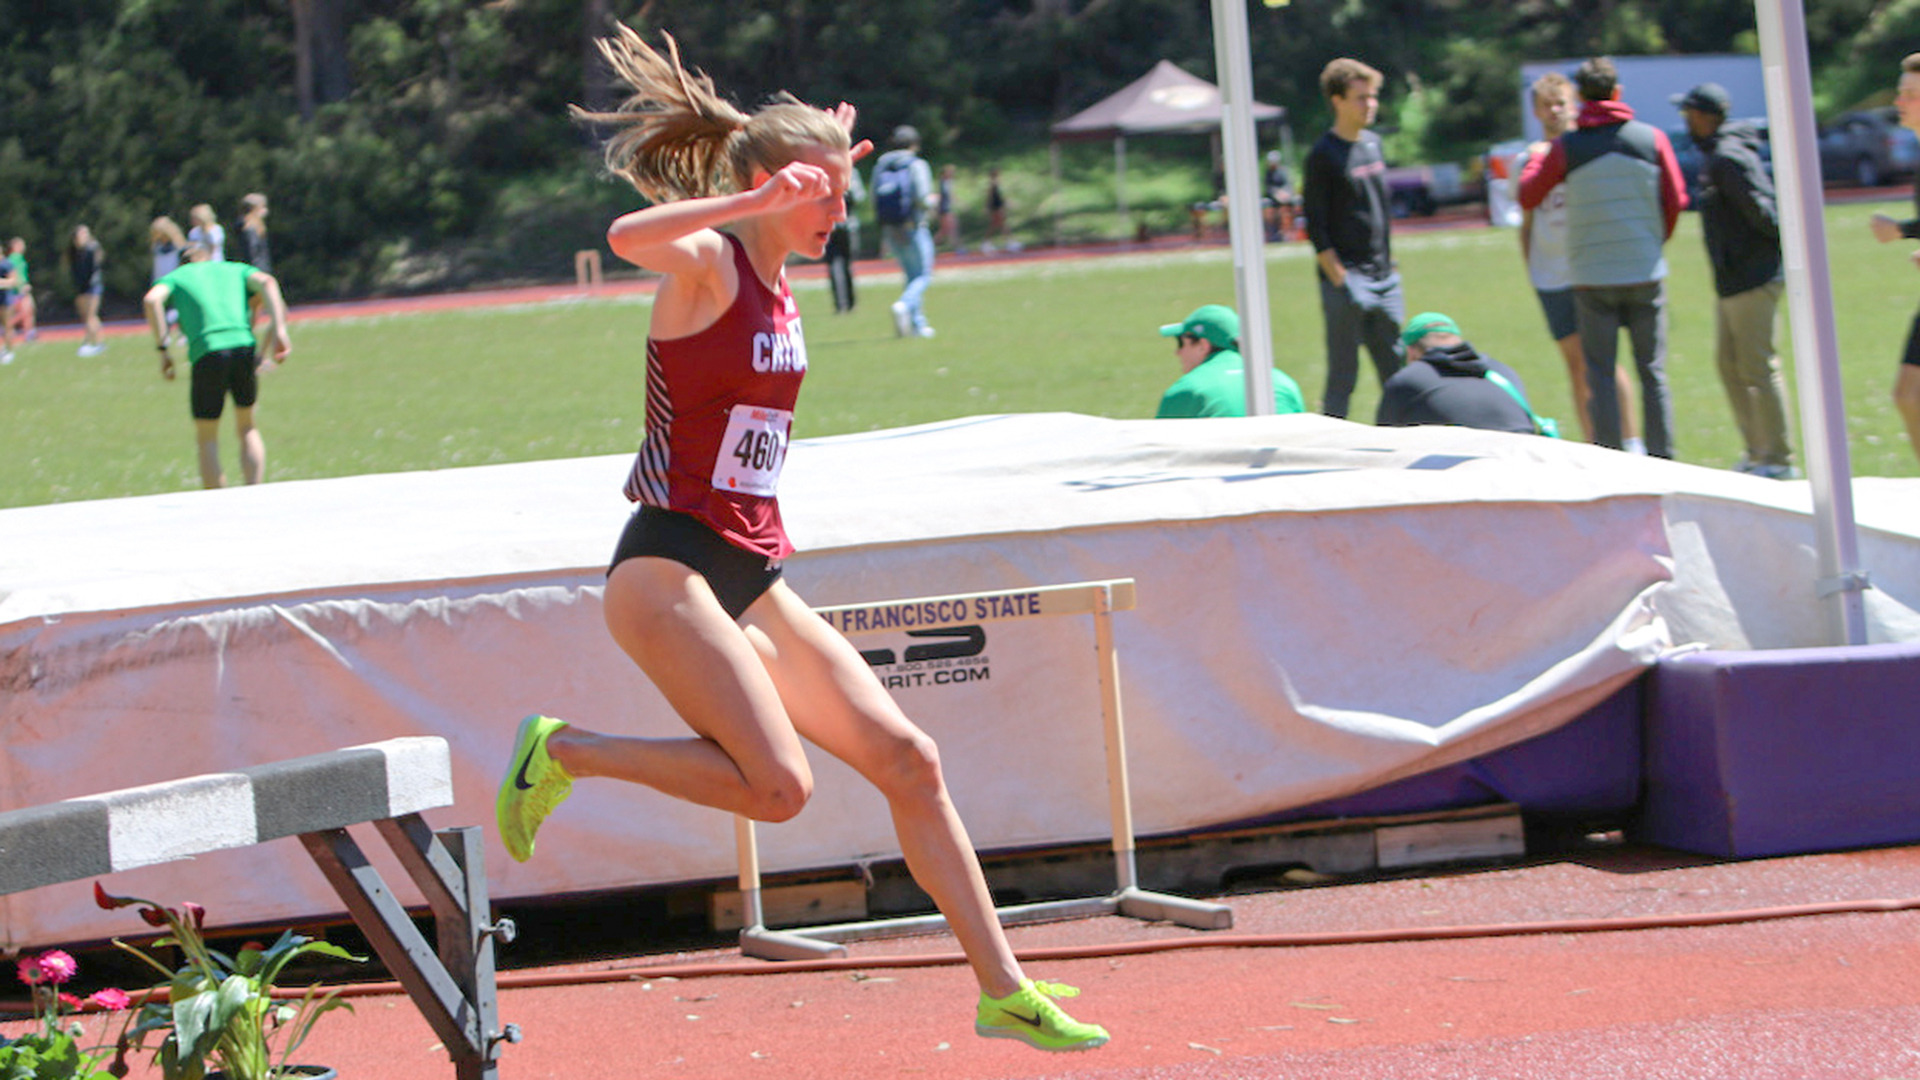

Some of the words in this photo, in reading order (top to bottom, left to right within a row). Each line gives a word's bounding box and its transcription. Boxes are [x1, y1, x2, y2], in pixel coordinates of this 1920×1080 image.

[733, 429, 779, 472] 460
[842, 600, 967, 632] FRANCISCO
[975, 592, 1041, 619] STATE
